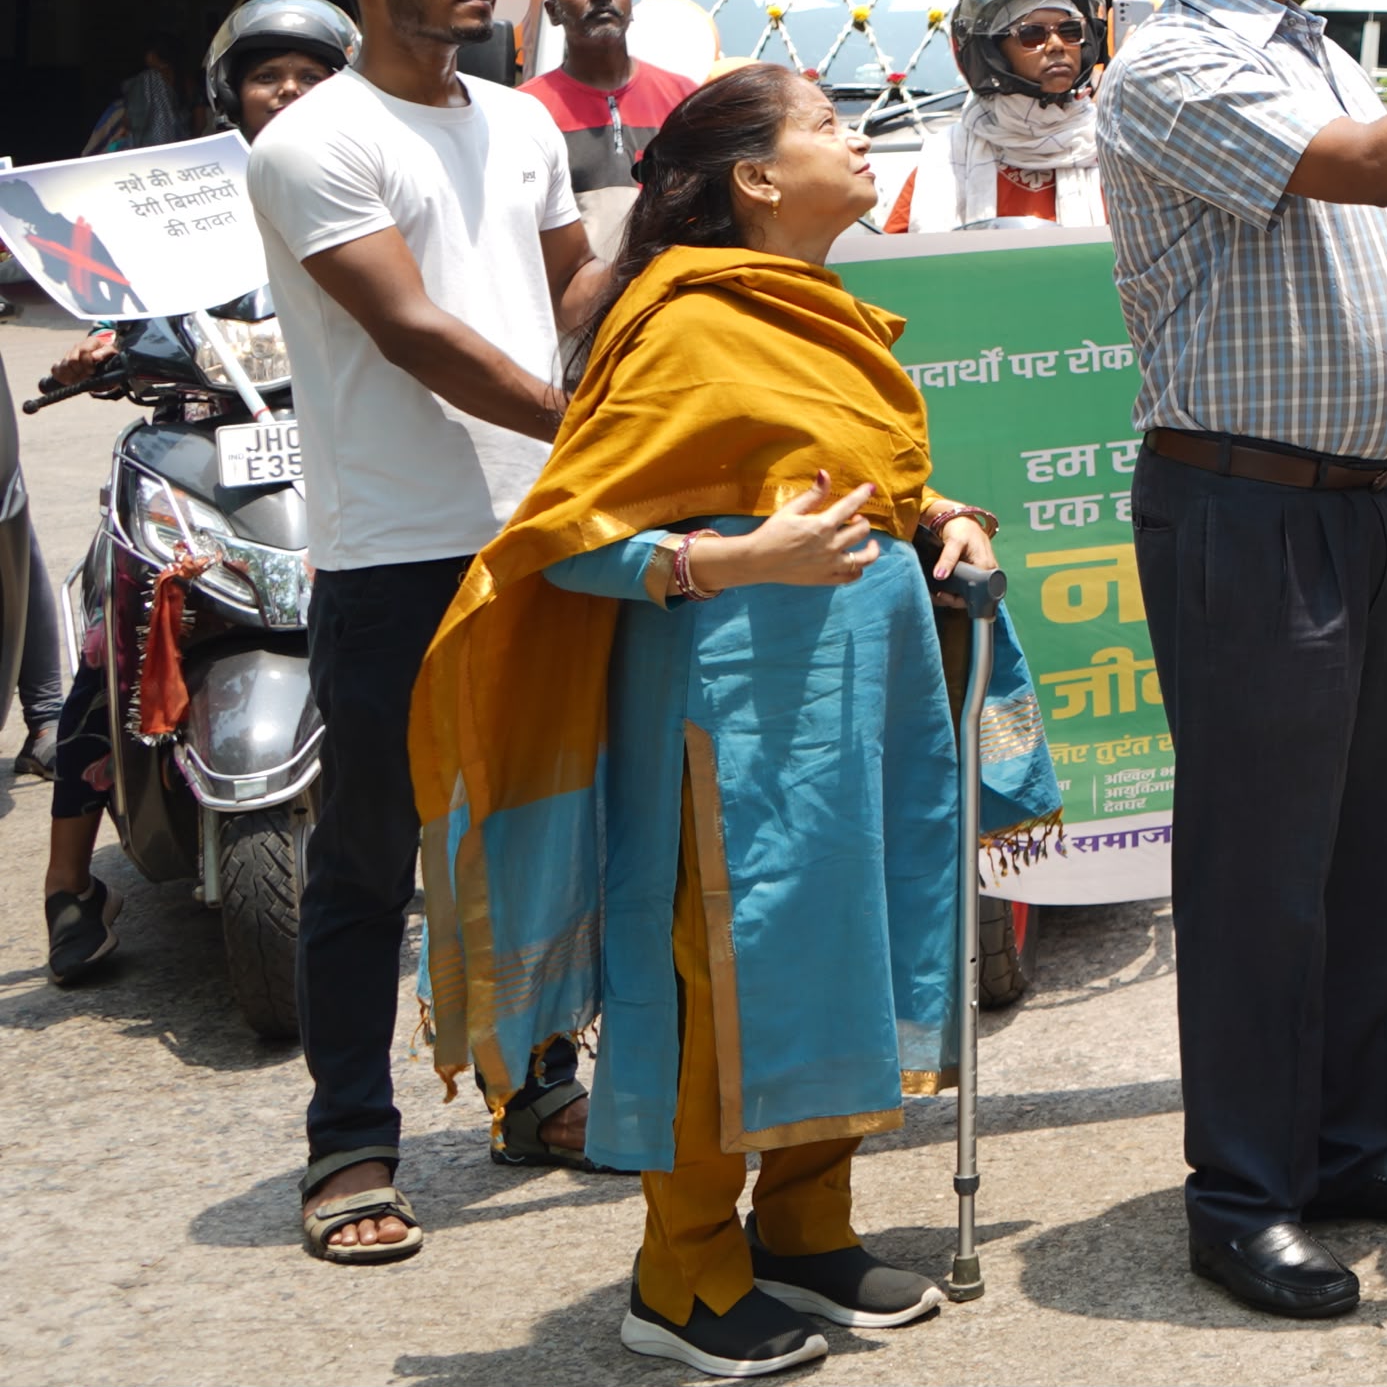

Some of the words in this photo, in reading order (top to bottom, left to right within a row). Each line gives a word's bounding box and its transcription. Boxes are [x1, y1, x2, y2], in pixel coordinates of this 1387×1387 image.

[115, 173, 146, 195] नशे
[147, 168, 173, 188] की
[177, 161, 225, 183] आदत
[129, 197, 163, 218] देगी
[163, 179, 240, 214] बिमारियों
[164, 220, 189, 238] की
[192, 211, 237, 233] दावत
[1008, 351, 1059, 379] पर
[1064, 339, 1135, 374] रोक
[1020, 443, 1100, 483] हम
[1023, 494, 1104, 532] एक
[1094, 734, 1153, 765] तुरंत
[1104, 768, 1156, 785] अखिल
[1103, 797, 1148, 813] देवघर
